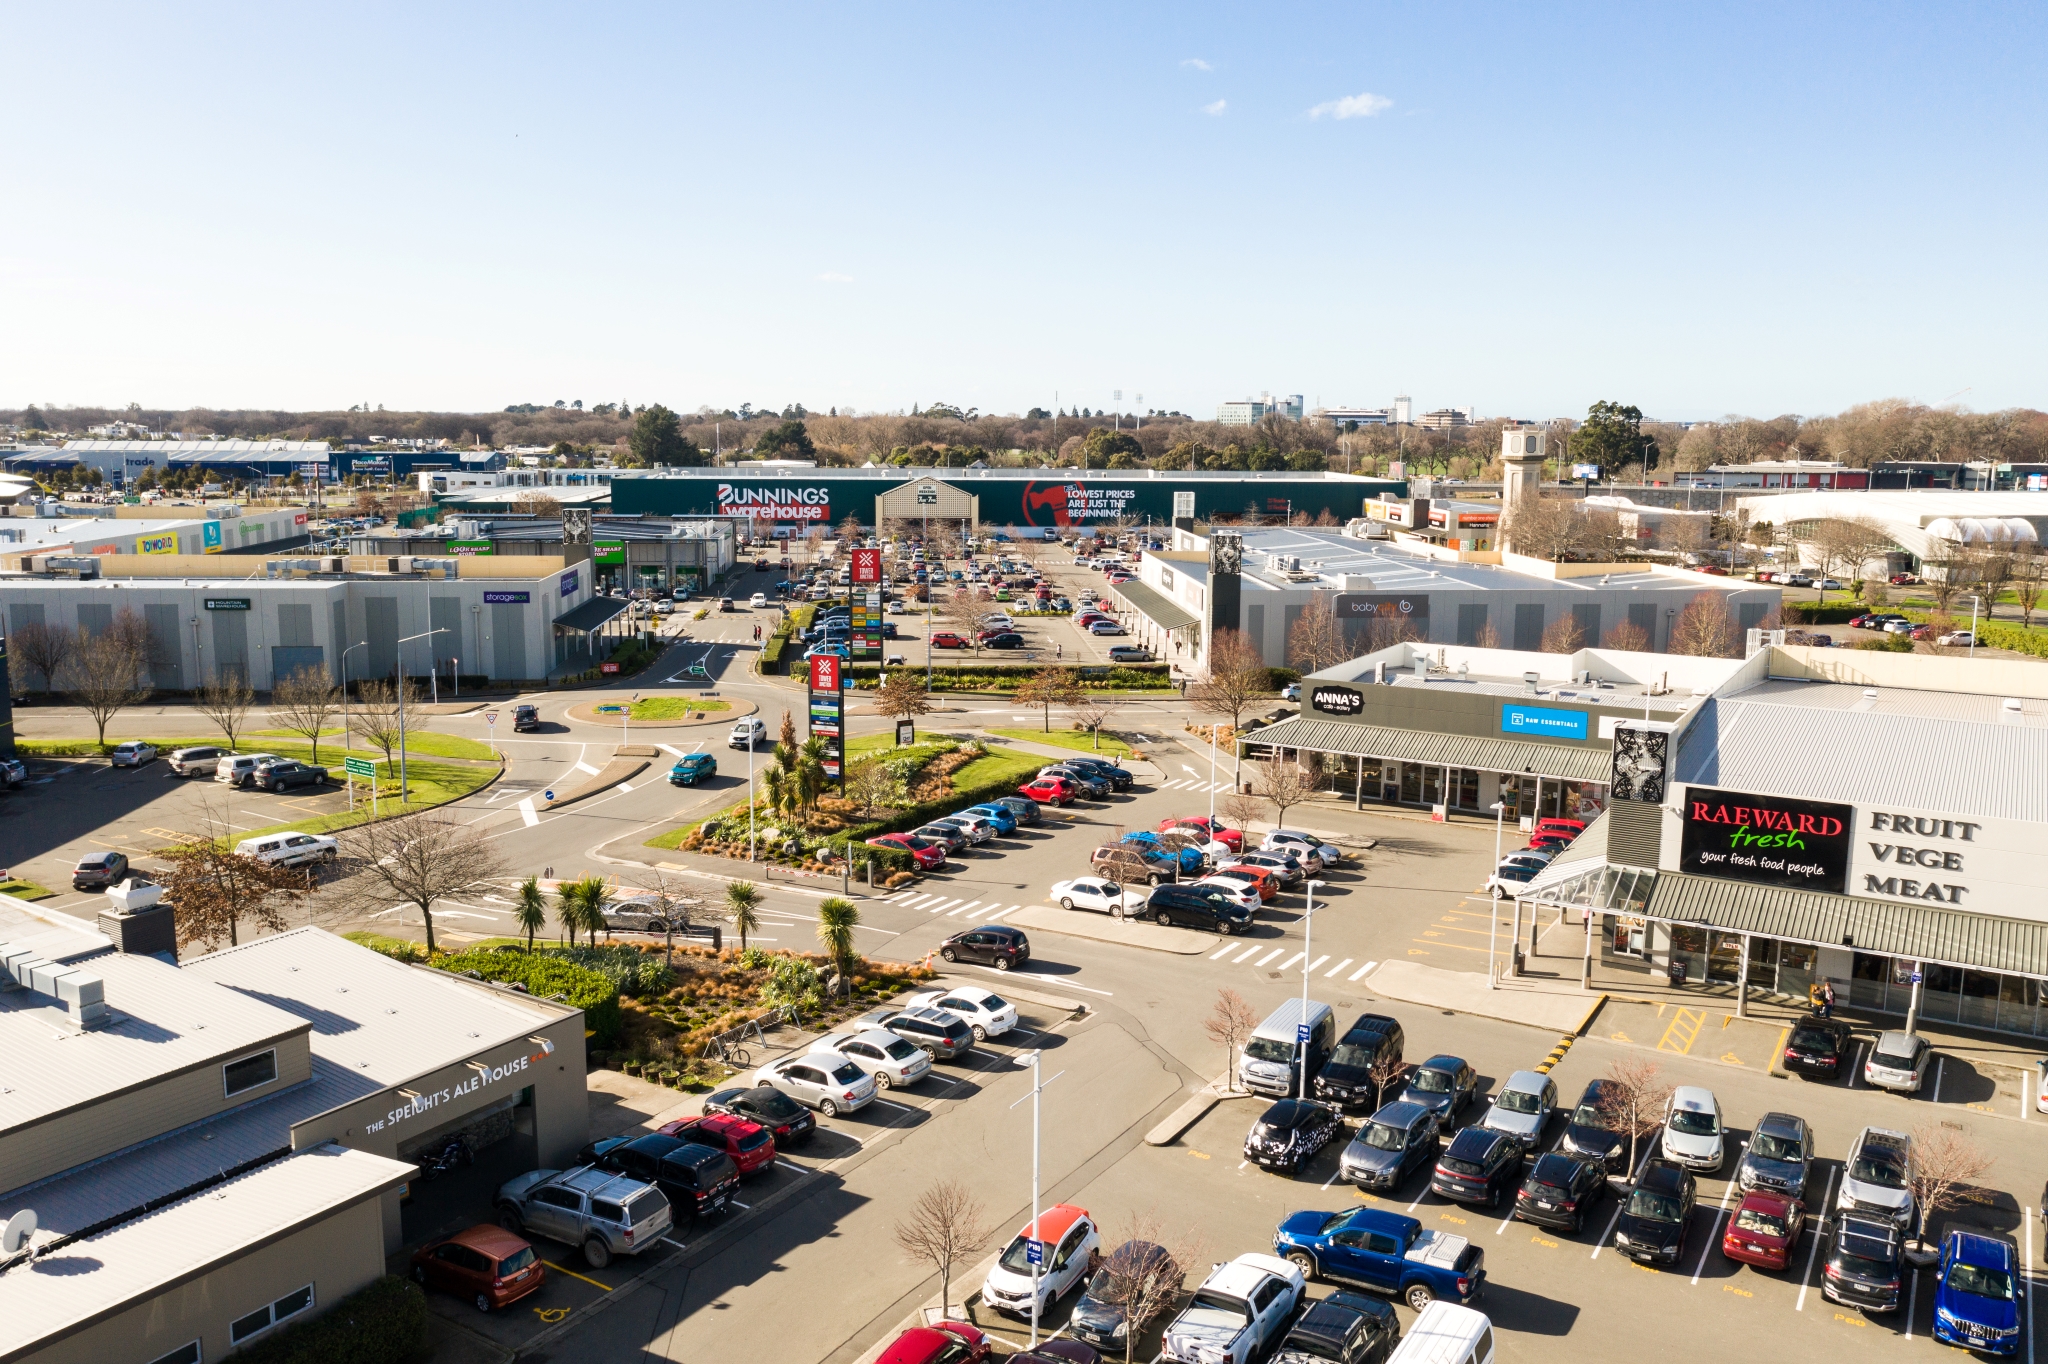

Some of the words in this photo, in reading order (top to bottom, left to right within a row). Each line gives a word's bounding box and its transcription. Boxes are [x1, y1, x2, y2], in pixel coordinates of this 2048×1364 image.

[126, 457, 155, 466] trade
[717, 484, 829, 505] BUNNINGS
[1067, 489, 1104, 498] LOWEST
[1106, 489, 1135, 499] PRICES
[1068, 499, 1085, 508] ARE
[1087, 499, 1108, 508] JUST
[1110, 499, 1126, 508] THE
[725, 501, 822, 519] warehouse
[142, 536, 173, 552] TOYWORLD
[1314, 691, 1360, 706] ANNA'S
[1540, 719, 1578, 728] ESSENTIALS
[1691, 801, 1843, 836] RAEWARD
[1869, 811, 1981, 841] FRUIT
[1729, 825, 1805, 850] fresh
[1700, 851, 1727, 864] your
[1730, 852, 1757, 867] fresh
[1760, 857, 1785, 871] food
[1787, 862, 1826, 878] people.
[1867, 842, 1963, 871] VEGE
[1864, 873, 1968, 904] MEAT
[365, 1120, 385, 1135] THE
[453, 1076, 479, 1099] ALE
